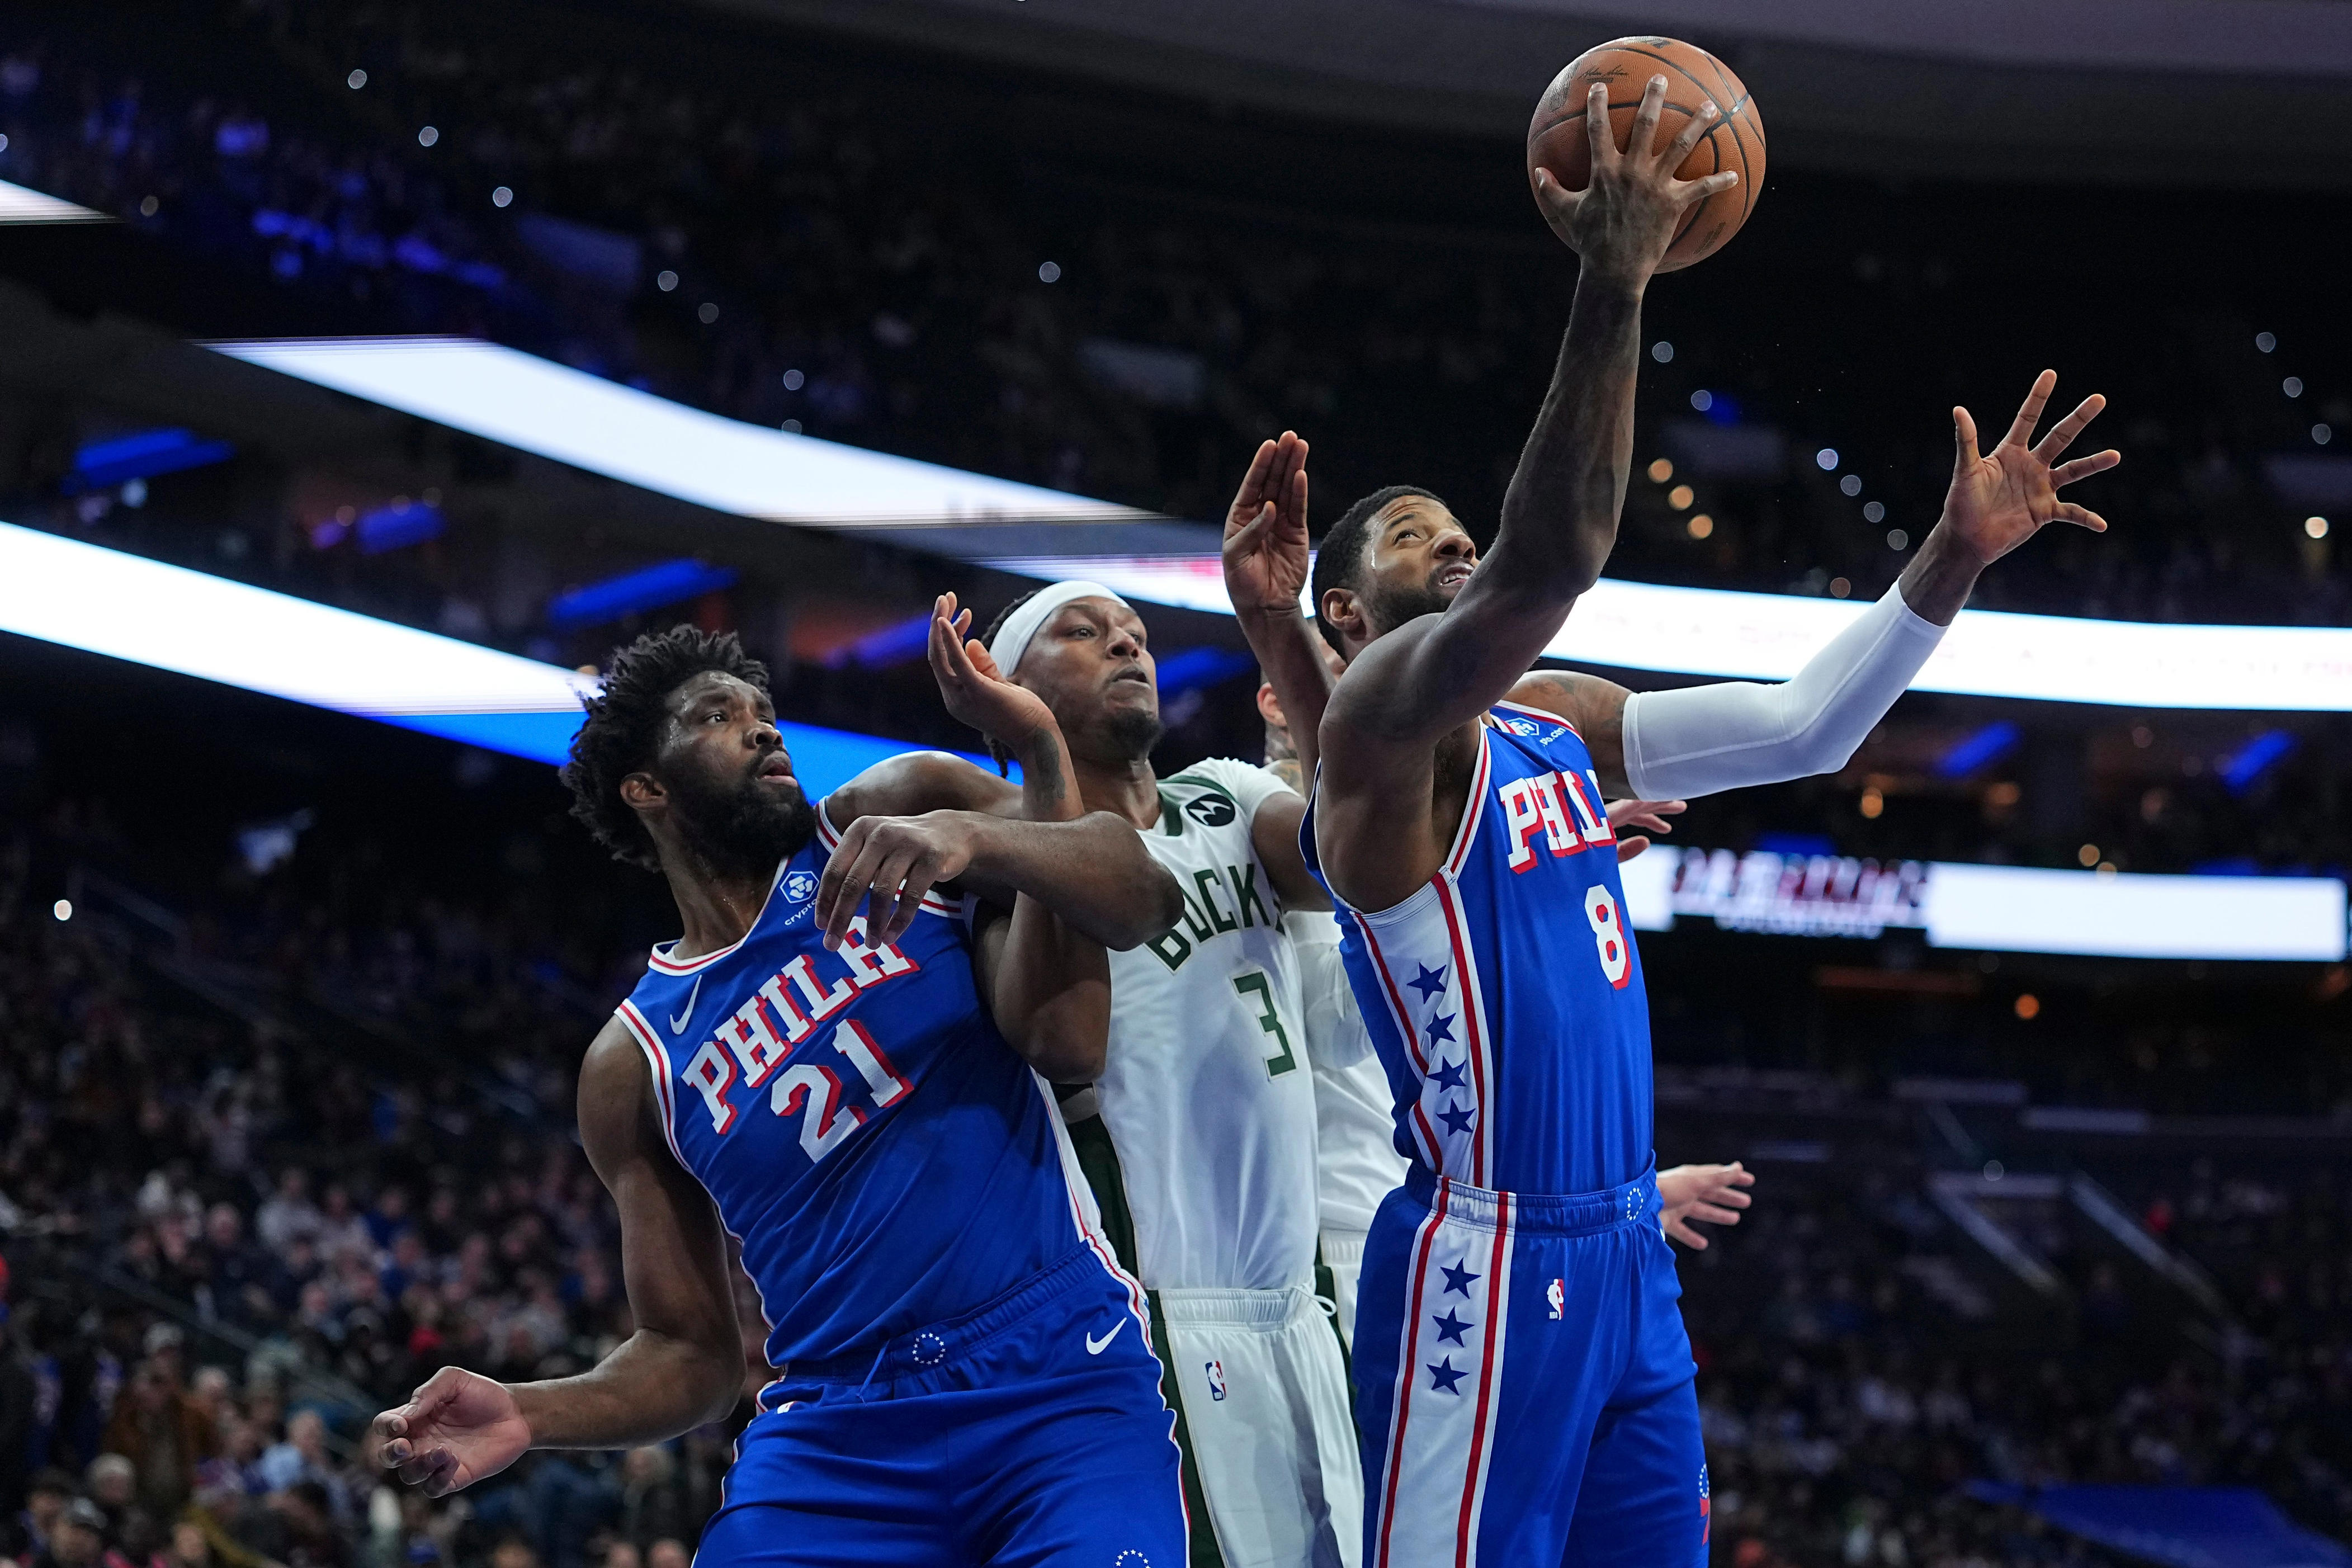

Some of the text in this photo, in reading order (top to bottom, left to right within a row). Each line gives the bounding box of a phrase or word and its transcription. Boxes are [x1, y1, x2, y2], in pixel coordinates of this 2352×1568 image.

[1584, 884, 1632, 990] 8
[681, 916, 920, 1135] PHILA
[1232, 970, 1297, 1079] 3
[770, 1018, 914, 1165] 21
